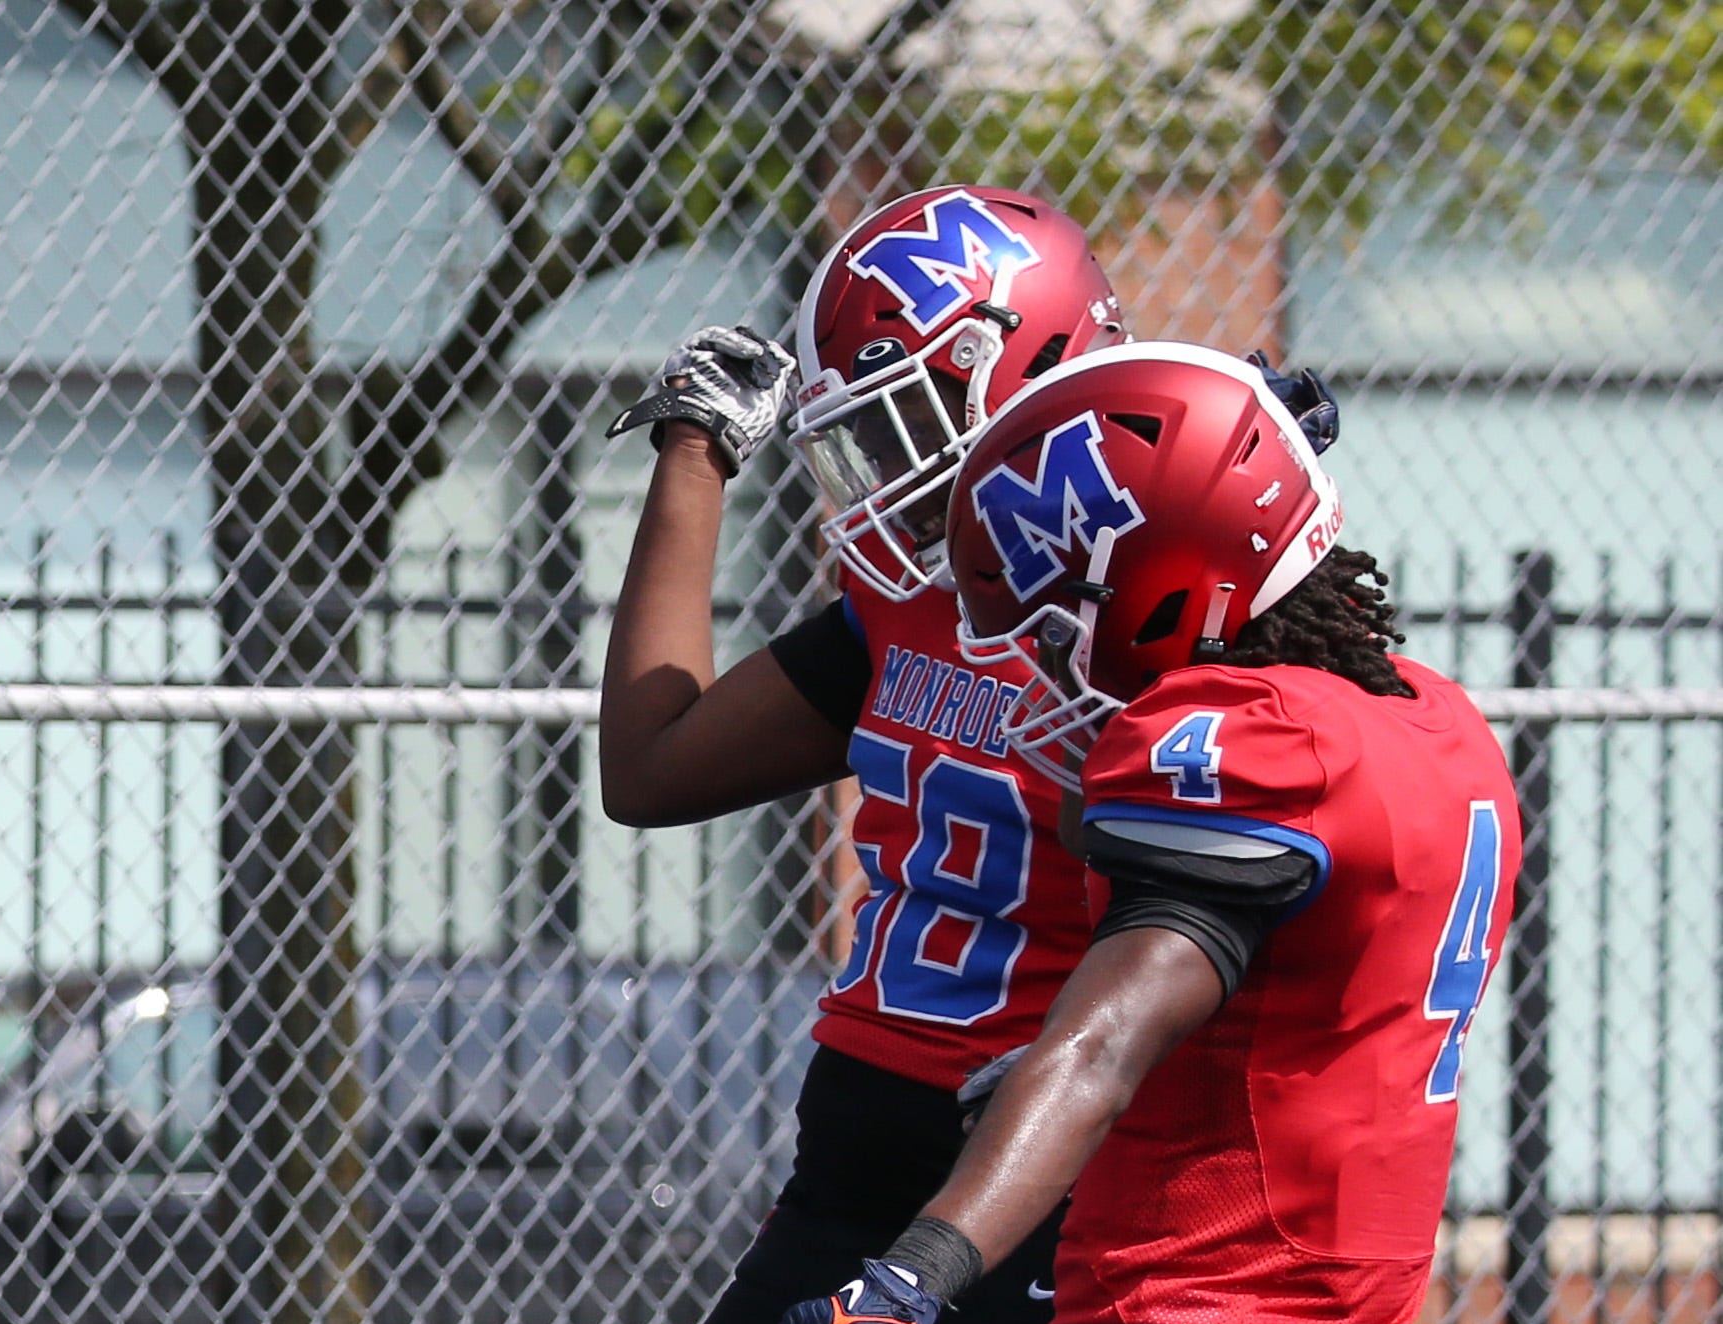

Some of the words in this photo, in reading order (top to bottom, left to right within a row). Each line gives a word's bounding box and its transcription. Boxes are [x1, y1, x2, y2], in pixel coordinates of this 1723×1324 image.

[847, 189, 1041, 336] M
[971, 410, 1146, 602] M
[1250, 532, 1269, 552] 4
[871, 645, 1027, 759] MONROE
[1150, 710, 1224, 804] 4
[828, 727, 1033, 1026] 58
[1424, 800, 1501, 1104] 4
